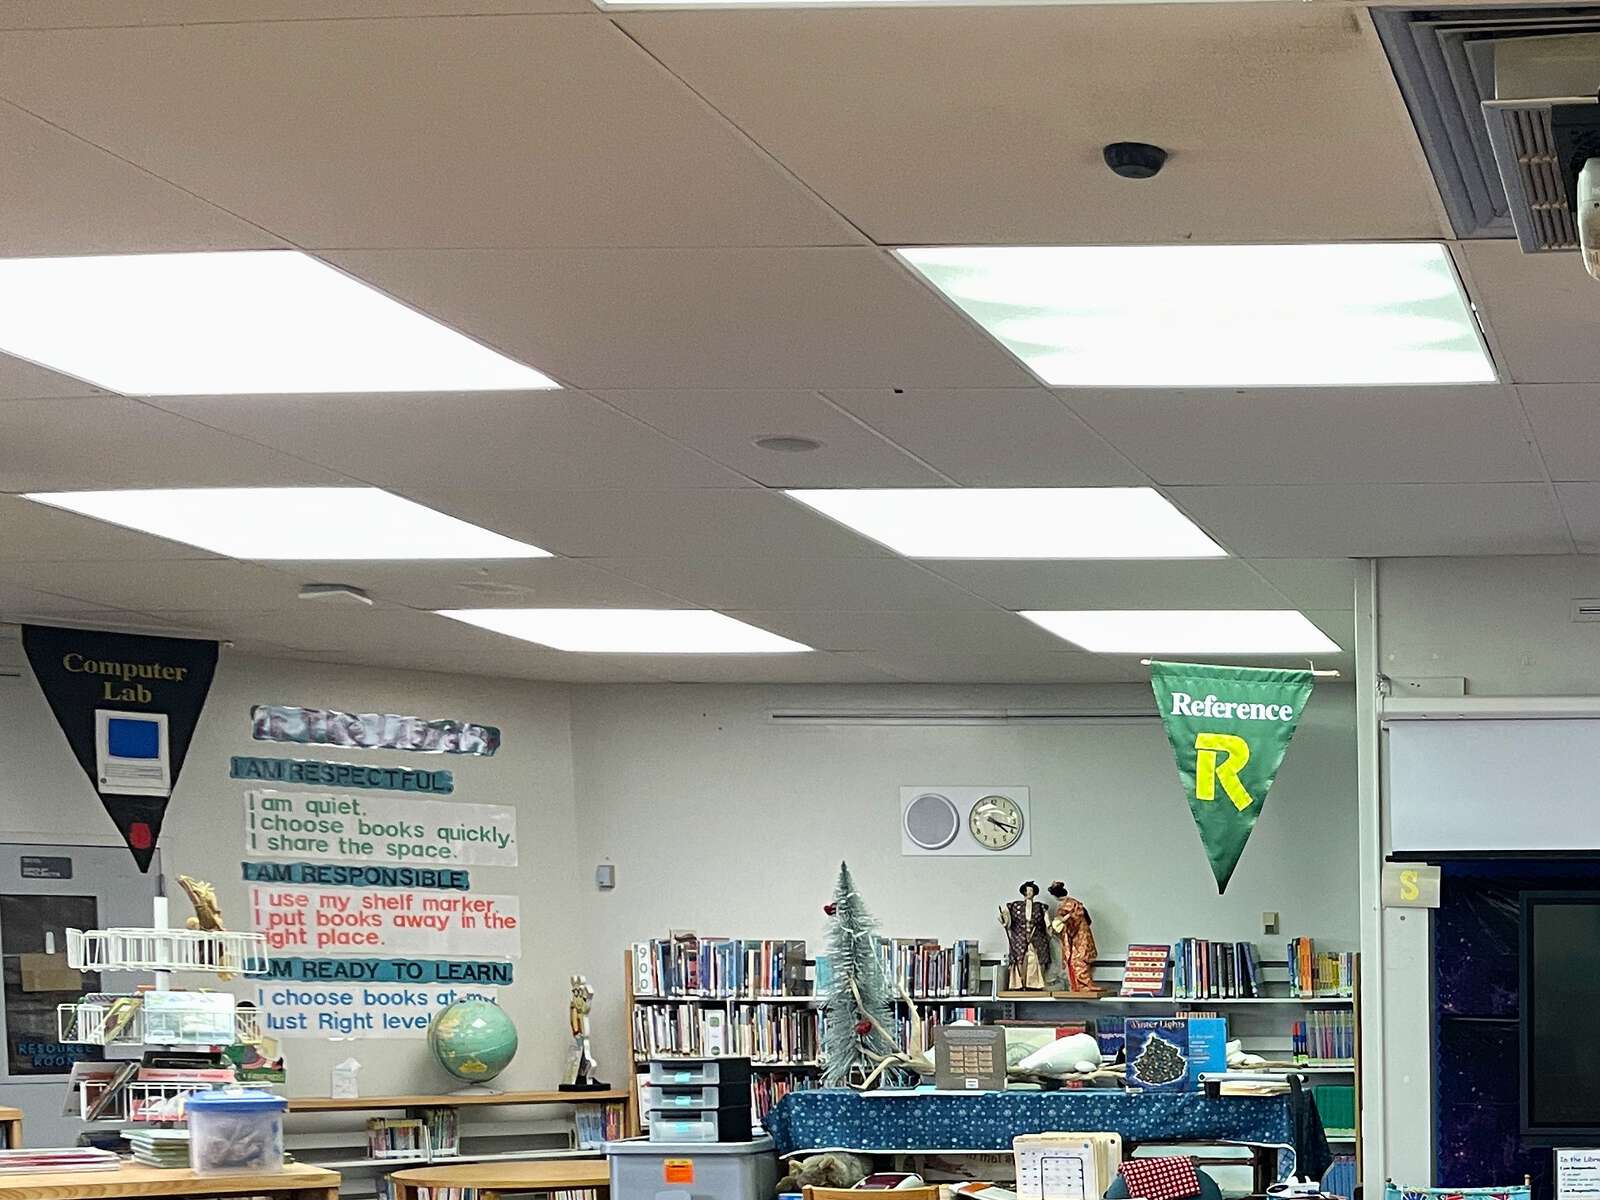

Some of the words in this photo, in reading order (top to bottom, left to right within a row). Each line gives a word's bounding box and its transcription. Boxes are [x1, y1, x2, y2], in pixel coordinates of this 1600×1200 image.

[63, 653, 188, 681] Computer
[103, 681, 152, 703] Lab
[1170, 691, 1293, 722] Reference
[247, 760, 282, 778] AM
[1195, 732, 1253, 811] R
[261, 798, 292, 812] am
[306, 799, 367, 817] quiet.
[261, 814, 344, 834] choose
[358, 819, 425, 839] books
[437, 823, 515, 849] quickly.
[268, 834, 328, 853] share
[339, 838, 374, 855] the
[387, 843, 458, 860] space.
[256, 865, 292, 882] AM
[1400, 870, 1420, 900] S
[269, 893, 309, 908] use
[320, 896, 351, 912] my
[362, 894, 413, 911] shelf
[269, 910, 306, 930] put
[316, 910, 382, 927] books
[393, 914, 449, 931] away
[462, 912, 476, 928] in
[484, 911, 517, 929] the
[255, 928, 308, 949] ight
[317, 928, 385, 948] place.
[303, 961, 379, 979] READY
[392, 962, 423, 979] TO
[435, 963, 513, 982] LEARN.
[272, 989, 353, 1006] choose
[364, 989, 428, 1006] books
[319, 1012, 375, 1034] Right
[384, 1013, 432, 1030] level
